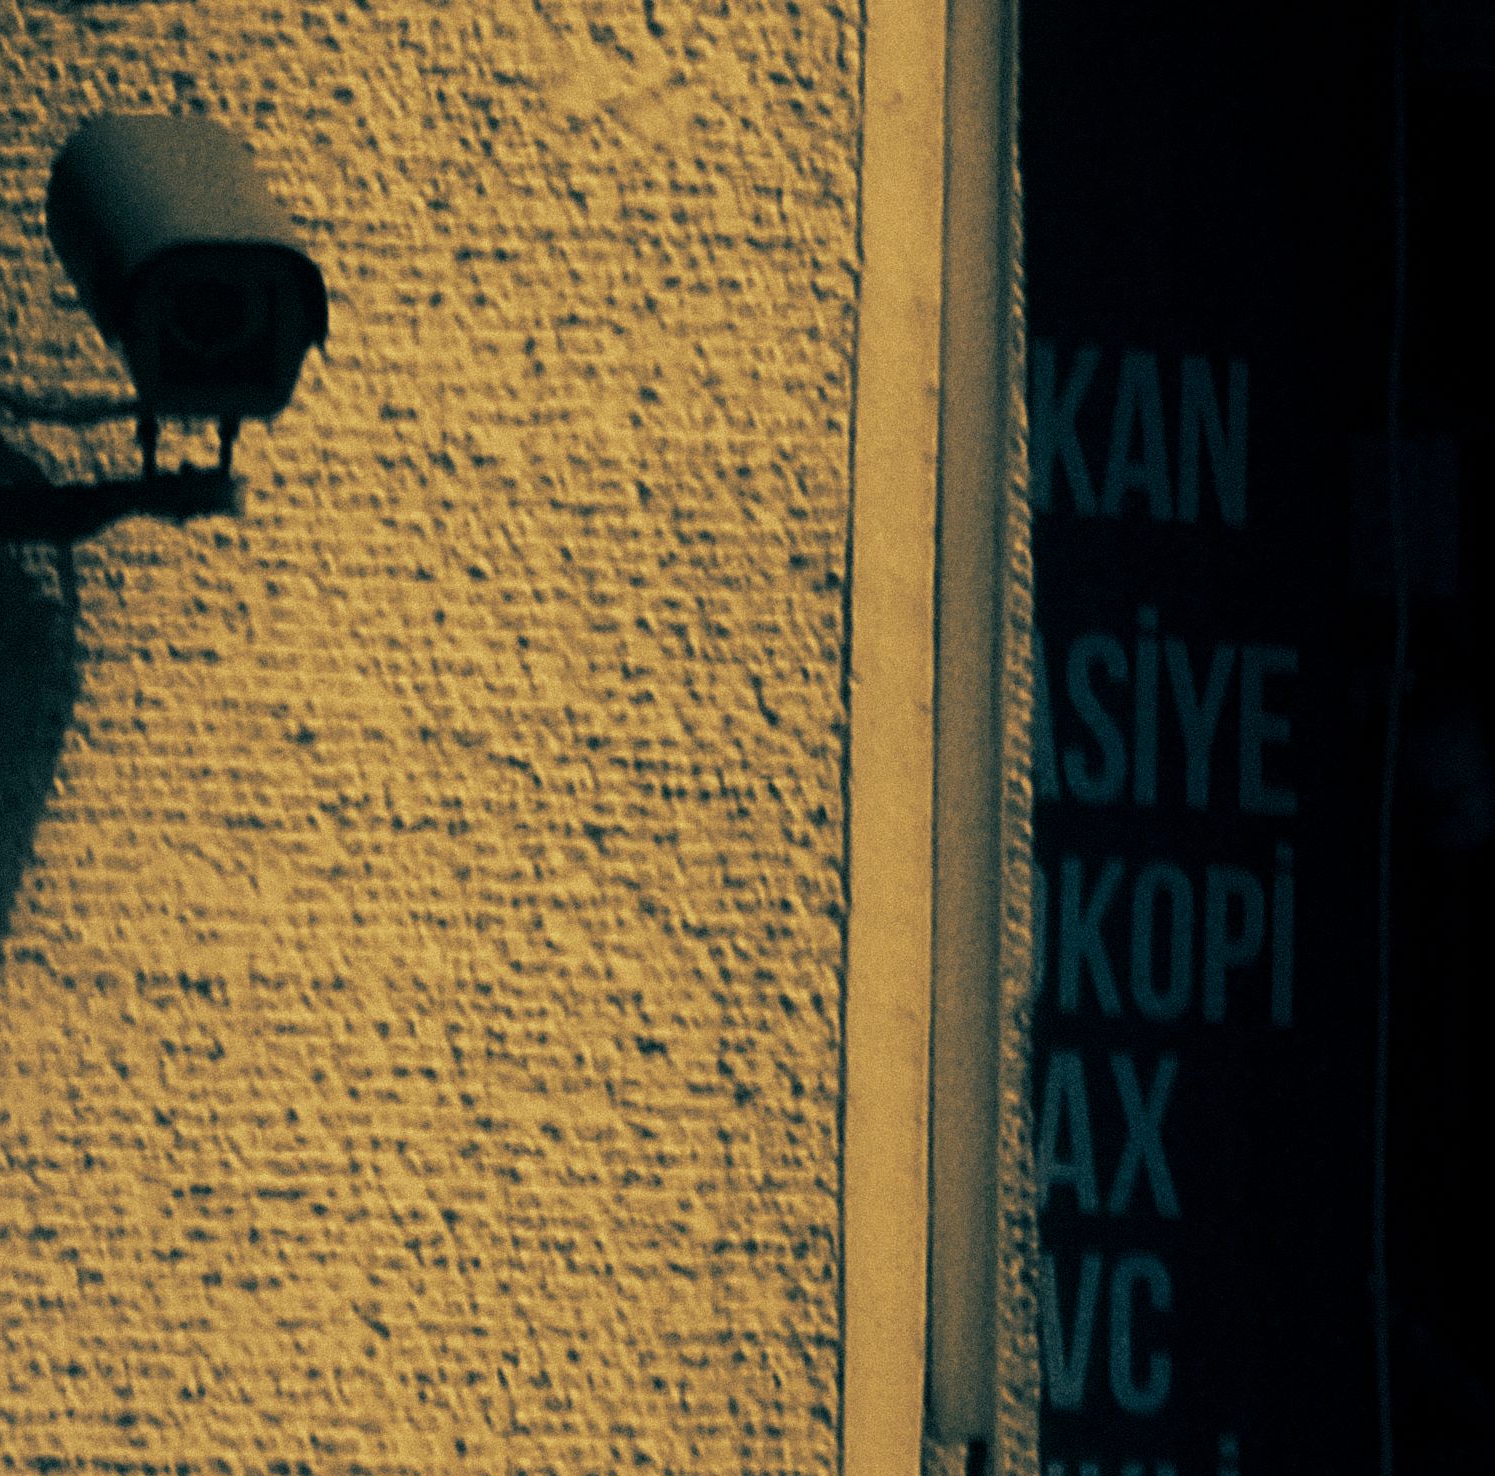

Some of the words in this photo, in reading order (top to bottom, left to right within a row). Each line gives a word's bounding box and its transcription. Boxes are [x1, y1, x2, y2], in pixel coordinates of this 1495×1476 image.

[1032, 336, 1253, 530] KAN
[1035, 1046, 1182, 1222] AX
[1040, 1251, 1174, 1416] VC
